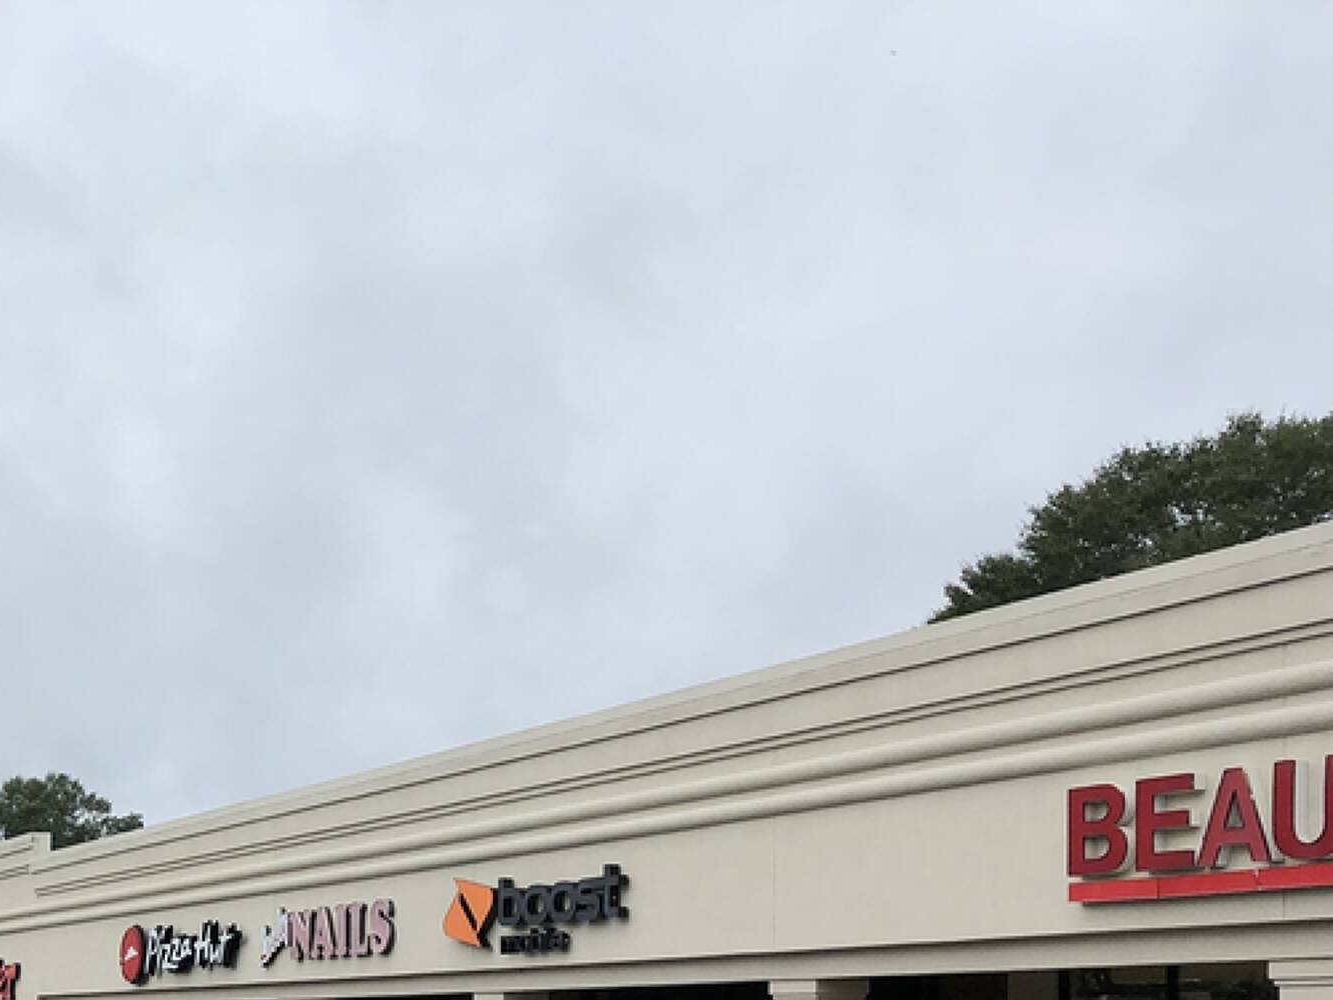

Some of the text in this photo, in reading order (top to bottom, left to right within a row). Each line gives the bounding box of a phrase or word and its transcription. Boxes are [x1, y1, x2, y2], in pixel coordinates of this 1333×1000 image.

[1068, 755, 1333, 877] BEAU
[498, 864, 629, 926] boost
[146, 920, 241, 977] Pizza Hut
[289, 901, 394, 962] NAILS
